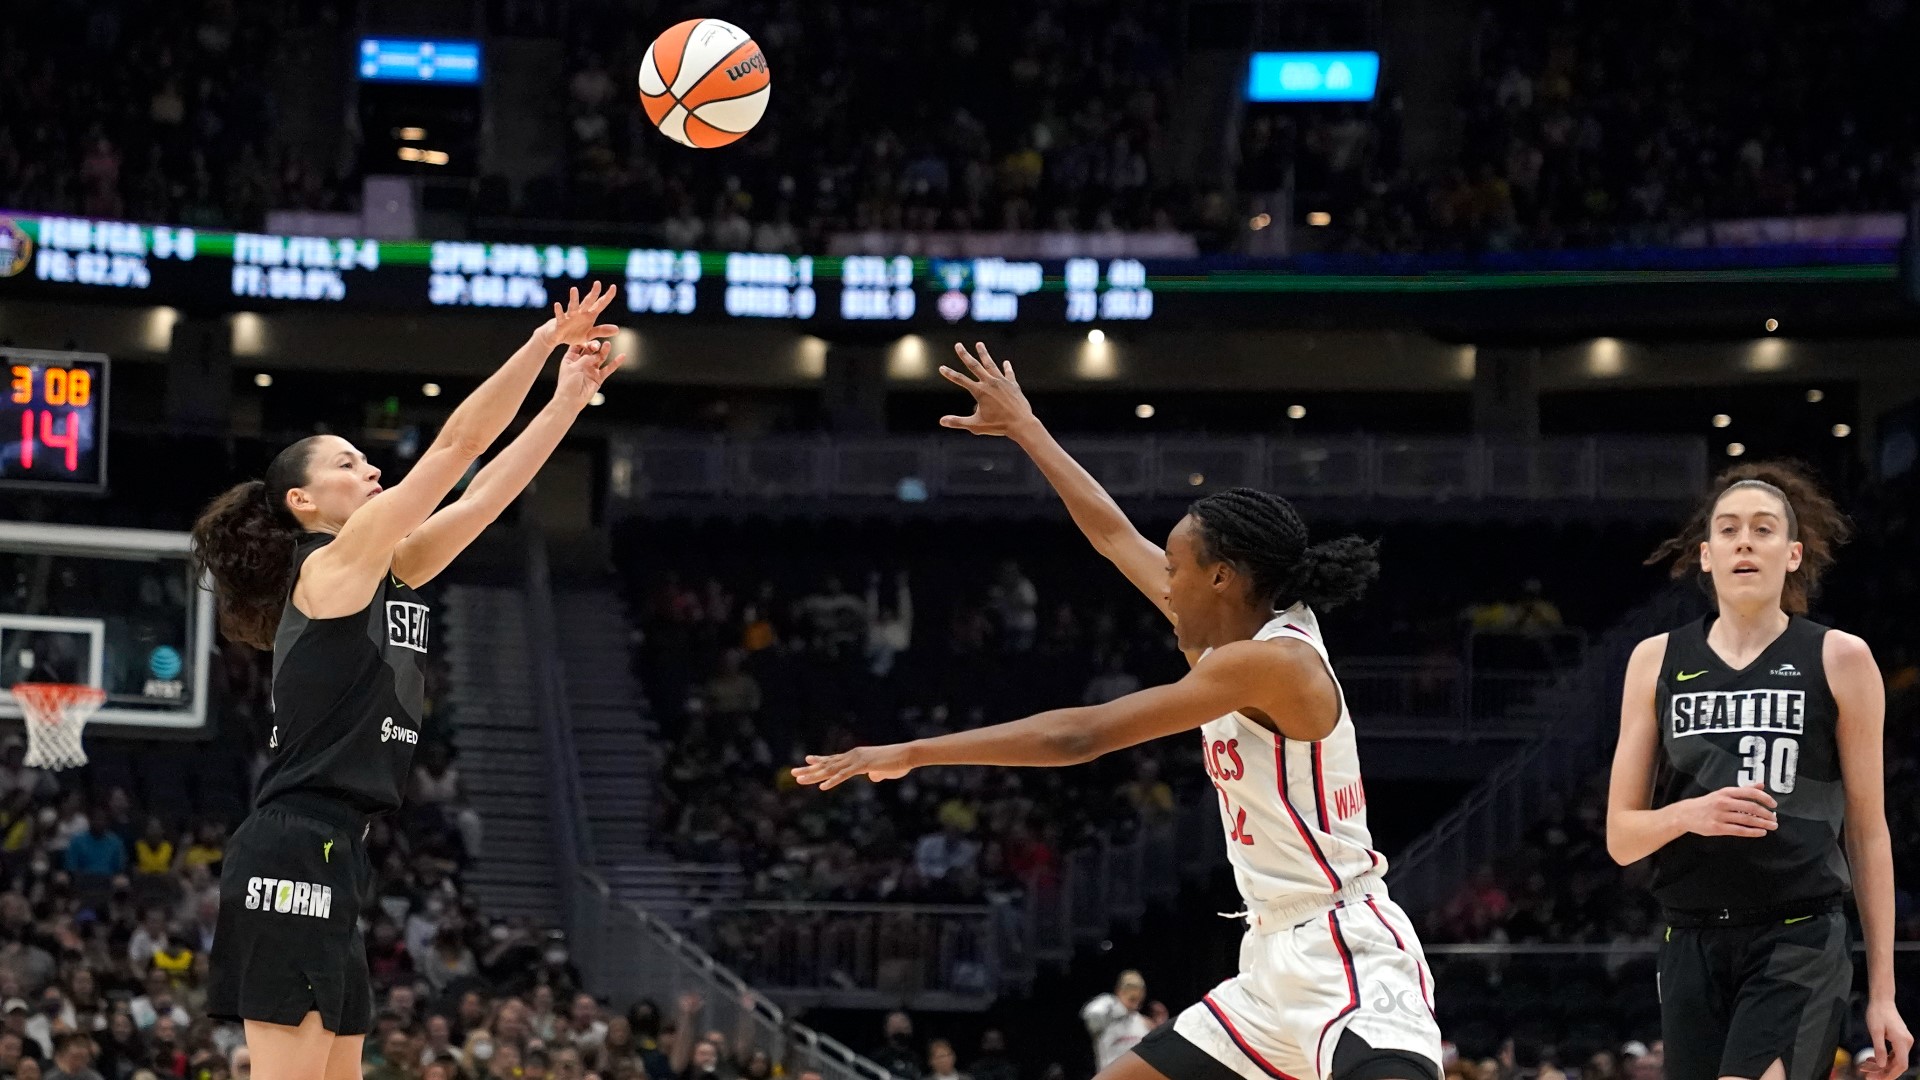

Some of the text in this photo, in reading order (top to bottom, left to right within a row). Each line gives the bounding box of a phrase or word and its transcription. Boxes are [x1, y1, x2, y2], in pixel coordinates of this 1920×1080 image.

[21, 408, 79, 472] 14
[1674, 692, 1802, 734] SEATTLE
[1737, 735, 1799, 794] 30
[245, 876, 332, 919] STORM
